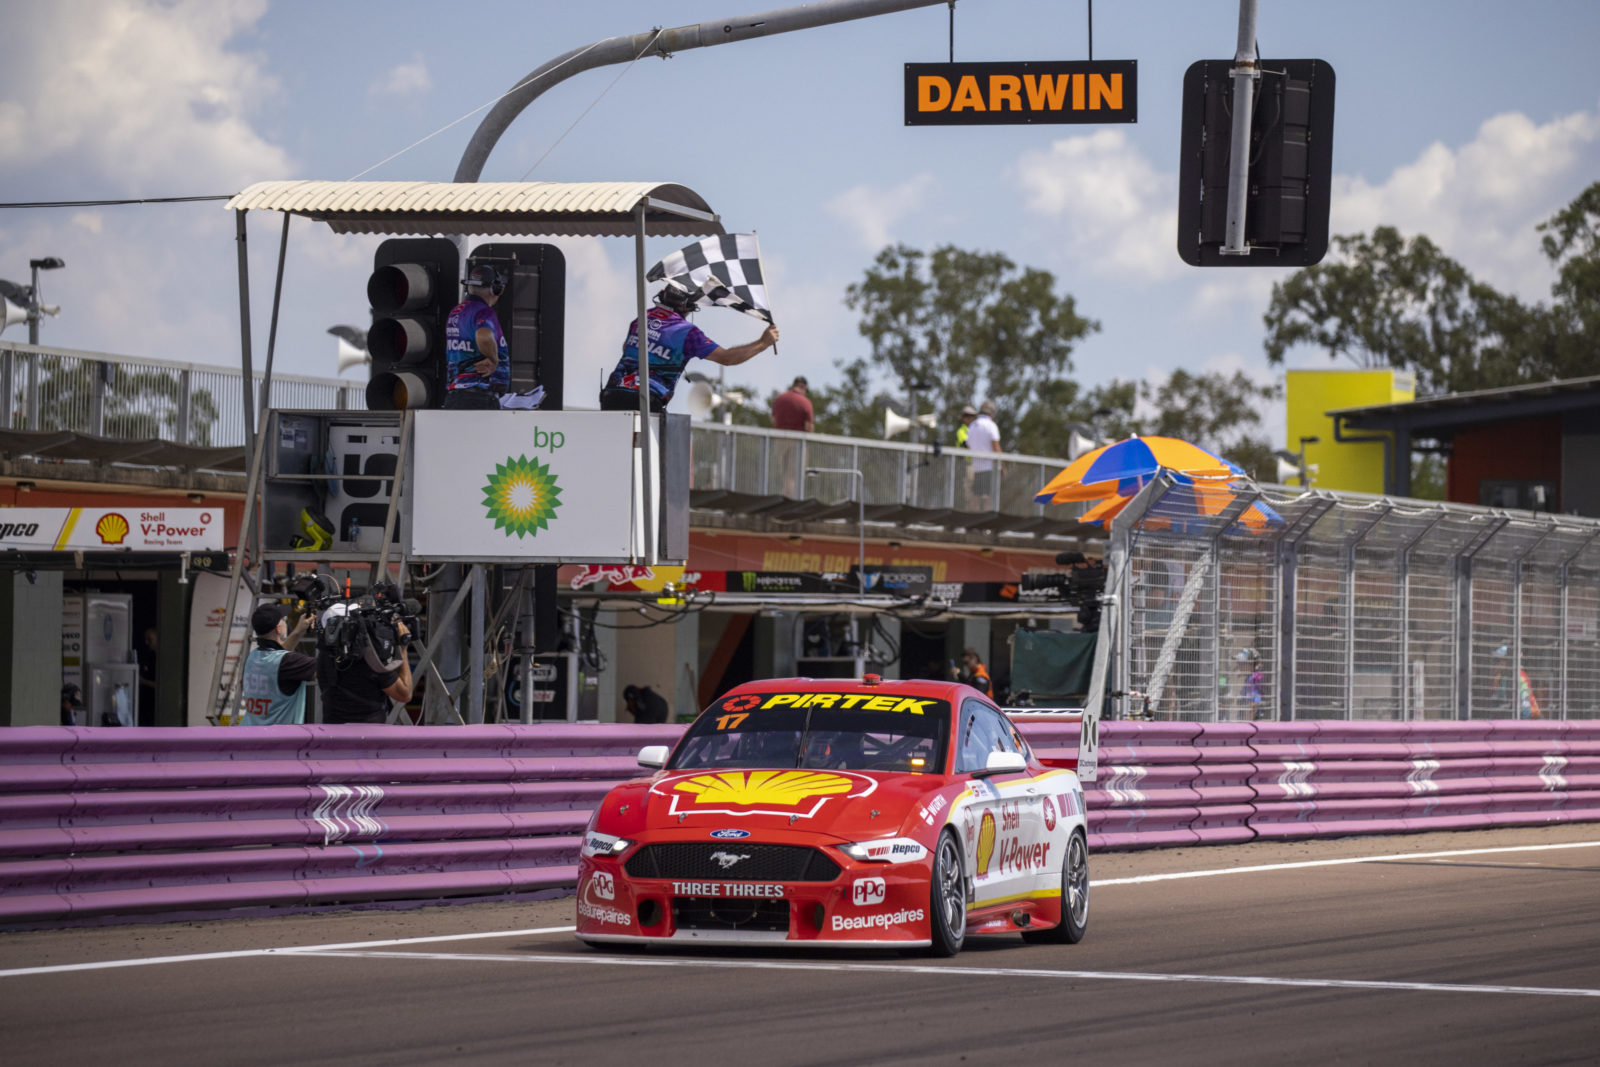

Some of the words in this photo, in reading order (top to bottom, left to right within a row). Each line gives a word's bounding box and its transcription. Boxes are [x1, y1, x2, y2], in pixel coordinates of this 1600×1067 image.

[917, 73, 1124, 113] DARWIN
[533, 426, 566, 454] bp
[140, 512, 165, 522] Shell
[0, 522, 40, 540] pco
[140, 523, 206, 537] V-Power
[760, 693, 939, 716] PIRTEK
[715, 712, 750, 731] 17
[1001, 800, 1020, 832] Shell
[589, 838, 613, 852] Repco
[891, 843, 921, 856] Repco
[999, 836, 1051, 875] V-Power
[672, 882, 721, 897] THREE
[723, 883, 785, 898] THREES
[578, 900, 632, 926] Beaurepaires
[831, 907, 925, 931] Beaurepaires
